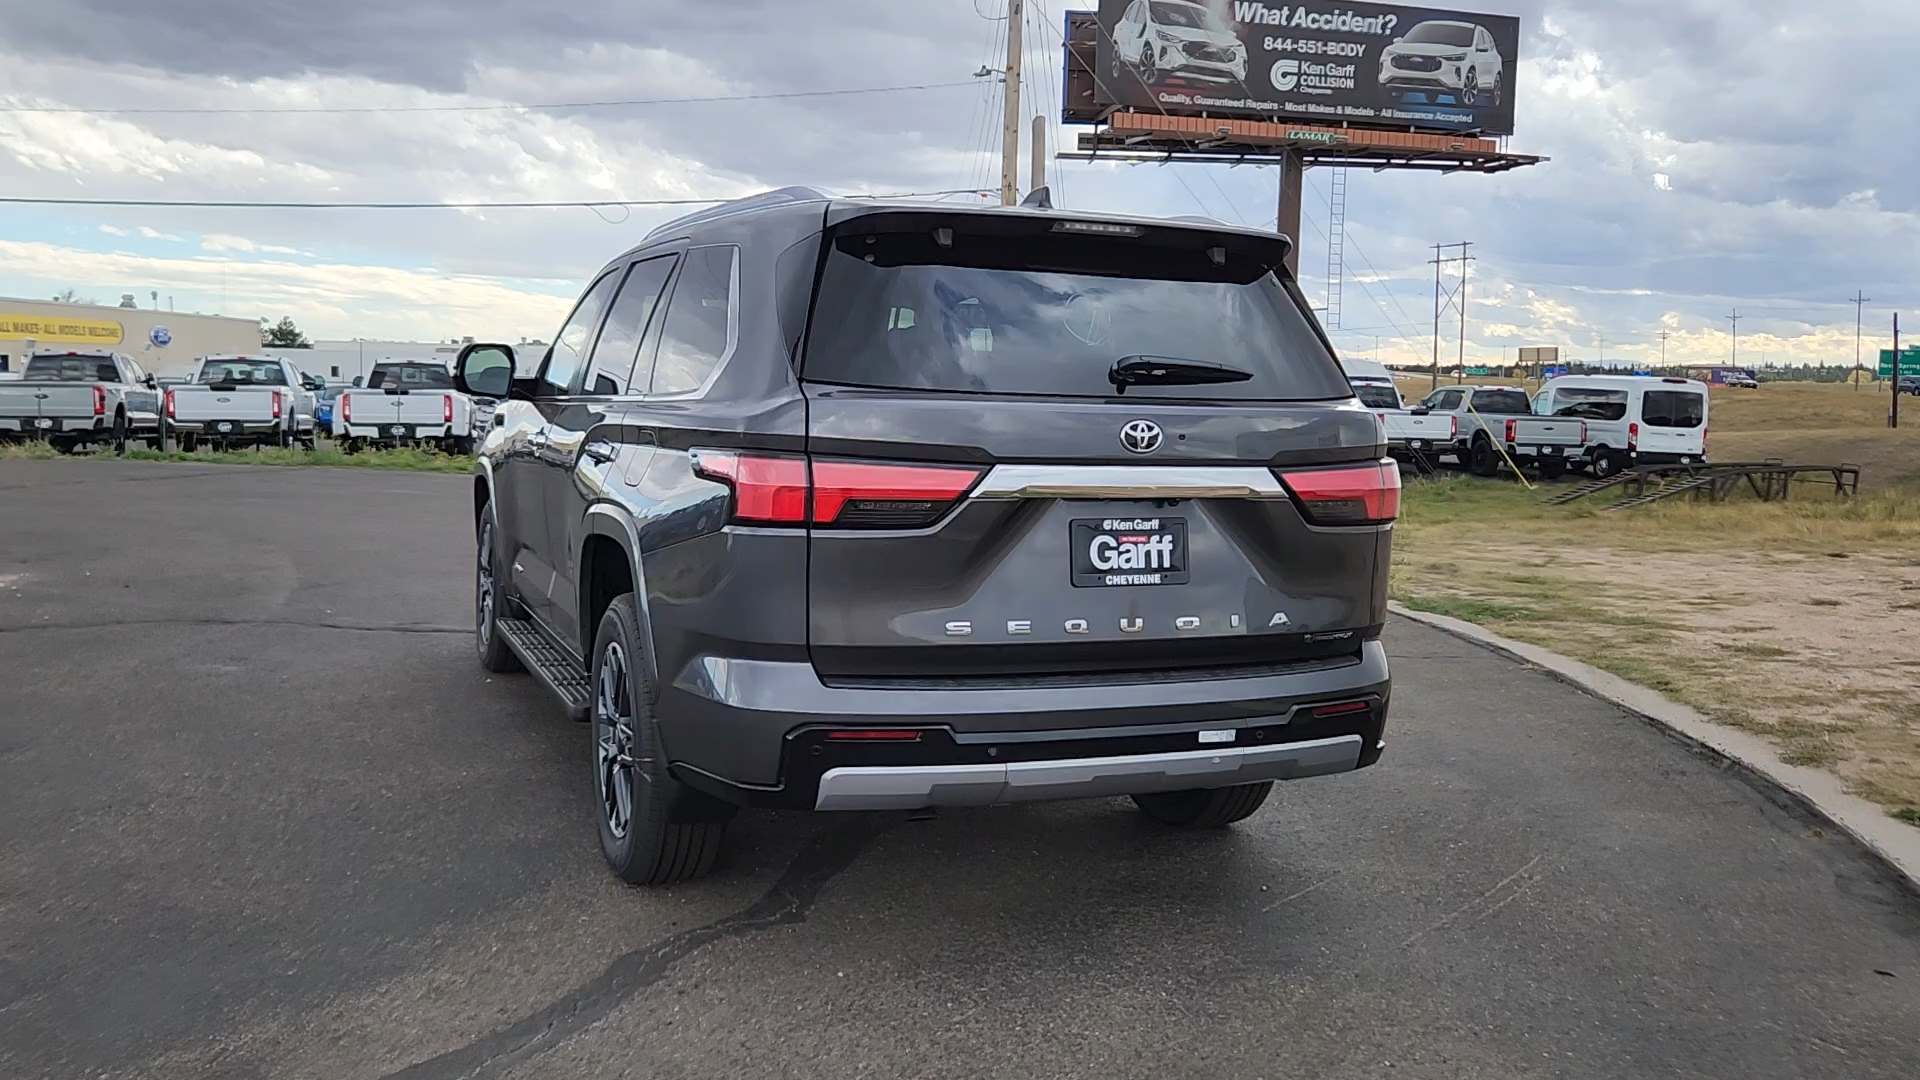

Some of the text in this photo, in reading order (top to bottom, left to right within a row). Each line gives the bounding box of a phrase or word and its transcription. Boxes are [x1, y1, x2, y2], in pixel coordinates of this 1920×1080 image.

[1234, 1, 1398, 35] What Accident?
[1263, 37, 1367, 57] 844-551-BODY
[1300, 61, 1356, 77] Ken Garff
[1300, 75, 1355, 89] COLLISION
[1159, 92, 1193, 105] Quality,
[1193, 95, 1245, 108] Guaranteed
[1245, 99, 1279, 110] Repairs
[1284, 102, 1307, 112] Most
[1307, 103, 1335, 114] Makes
[1336, 105, 1343, 114] &
[1344, 105, 1375, 116] Models
[1380, 108, 1392, 118] All
[1393, 109, 1434, 120] Insurance
[1435, 112, 1473, 123] Accepted
[1289, 131, 1331, 143] LAMAR
[58, 325, 86, 336] MODELS
[88, 327, 120, 337] WELCOME
[1112, 519, 1160, 530] Ken Garff
[1089, 534, 1173, 571] Garff
[1105, 574, 1162, 585] CHEYENNE
[944, 611, 1292, 635] SEQUOIA
